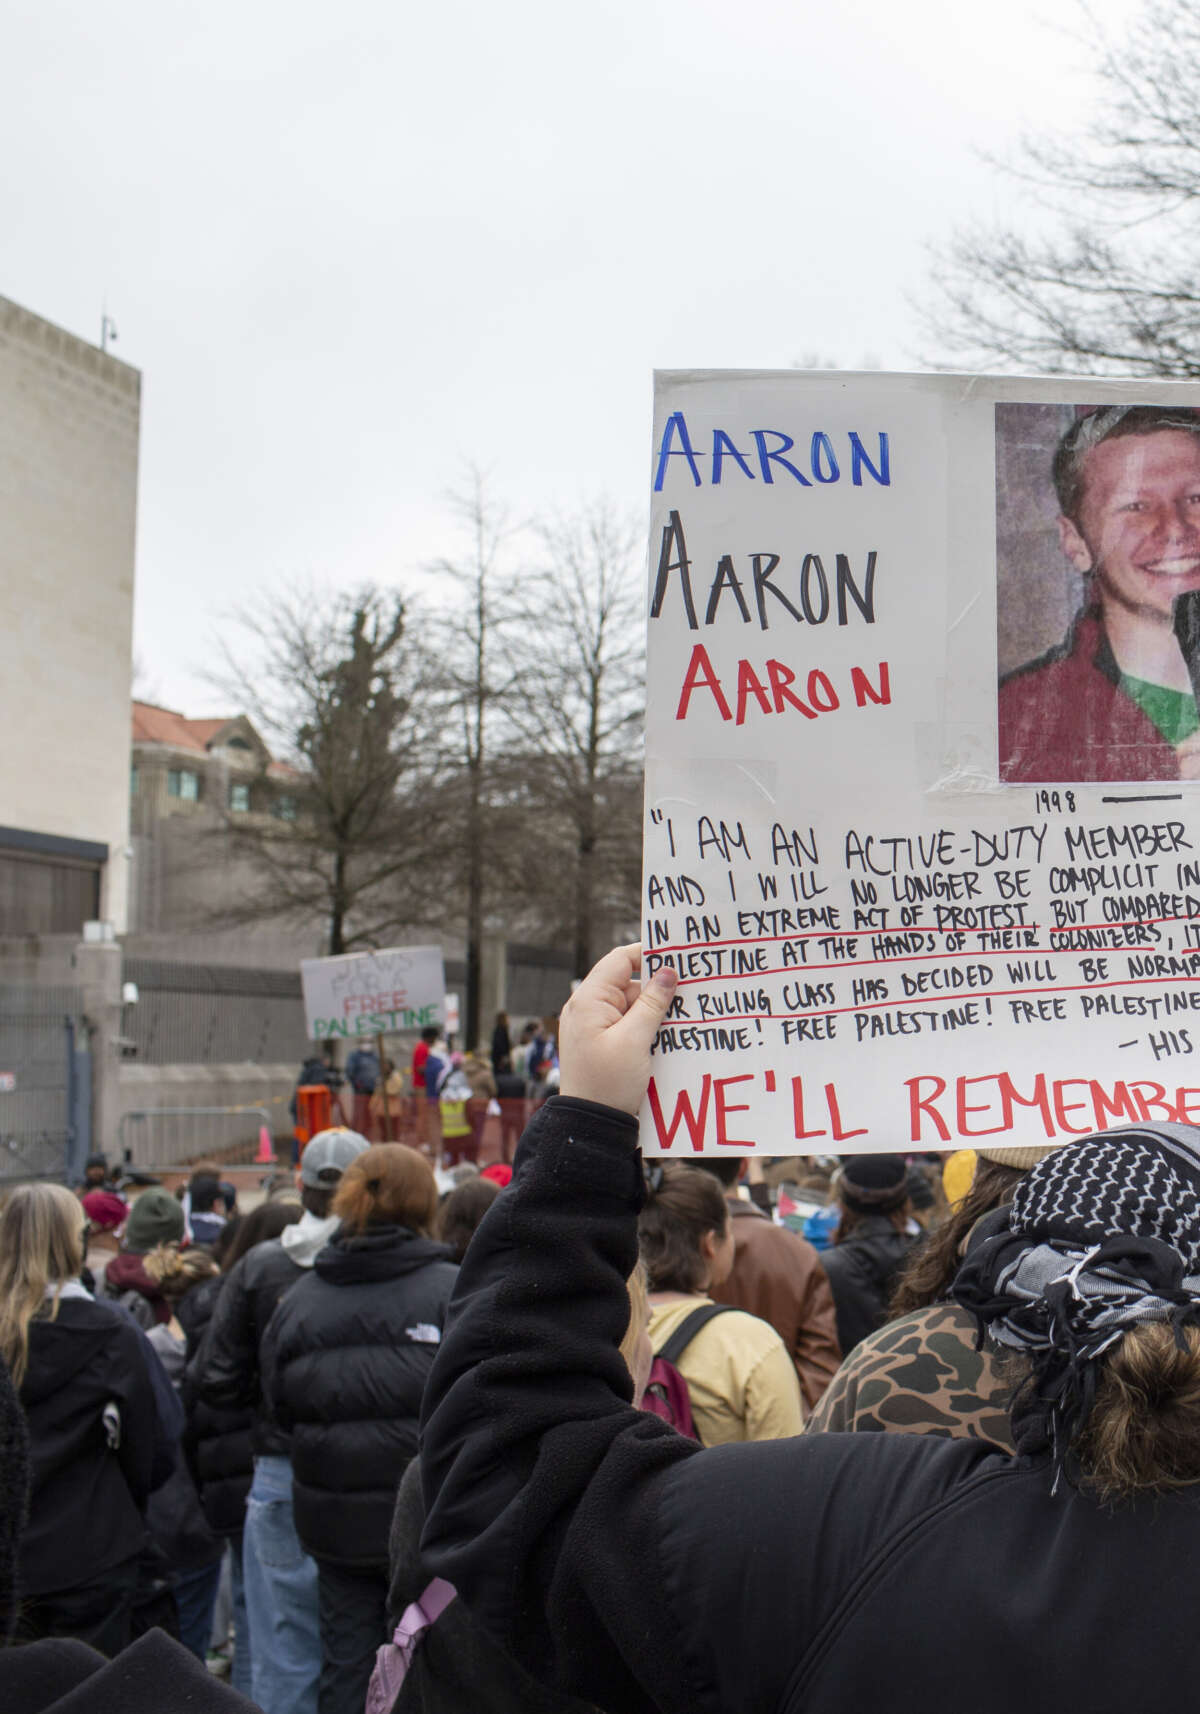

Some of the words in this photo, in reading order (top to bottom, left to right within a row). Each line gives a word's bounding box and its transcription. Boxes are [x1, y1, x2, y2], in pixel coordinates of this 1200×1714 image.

[653, 411, 891, 492] AARON
[650, 509, 878, 631] AARON
[675, 643, 892, 726] AARON
[1035, 789, 1076, 814] 1998
[698, 816, 751, 862] AM
[772, 823, 819, 867] AN
[845, 823, 1047, 876] ACTIVE-DUTY
[1065, 822, 1193, 862] MEMBER
[649, 874, 705, 909] AND
[729, 871, 736, 901] I
[758, 871, 828, 902] WILL
[851, 879, 877, 907] NO
[892, 871, 982, 902] LONGER
[994, 869, 1031, 899] BE
[1050, 863, 1158, 896] COMPLICIT
[1177, 860, 1200, 890] IN
[647, 919, 669, 949] IN
[686, 915, 721, 942] AN
[738, 906, 840, 937] EXTREME
[854, 908, 889, 930] ACT
[901, 905, 923, 927] OF
[933, 903, 1037, 934] PROTEST,
[1051, 898, 1088, 929] BUT
[1102, 892, 1200, 922] COMPARED
[646, 948, 768, 980] PALESTINE
[782, 939, 809, 967] AT
[818, 937, 858, 959] THE
[871, 932, 936, 960] HANDS
[946, 932, 966, 952] OF
[977, 930, 1039, 951] THEIR
[342, 989, 411, 1017] FREE
[698, 988, 773, 1021] RULING
[783, 982, 836, 1010] CLASS
[852, 978, 889, 1006] HAS
[902, 963, 993, 997] DECIDED
[1006, 959, 1057, 984] WILL
[1079, 957, 1109, 983] BE
[313, 1003, 440, 1039] PALESTINE
[781, 1014, 838, 1045] FREE
[854, 997, 993, 1041] PALESTINE!
[1008, 998, 1067, 1025] FREE
[646, 1069, 869, 1152] WE'LL
